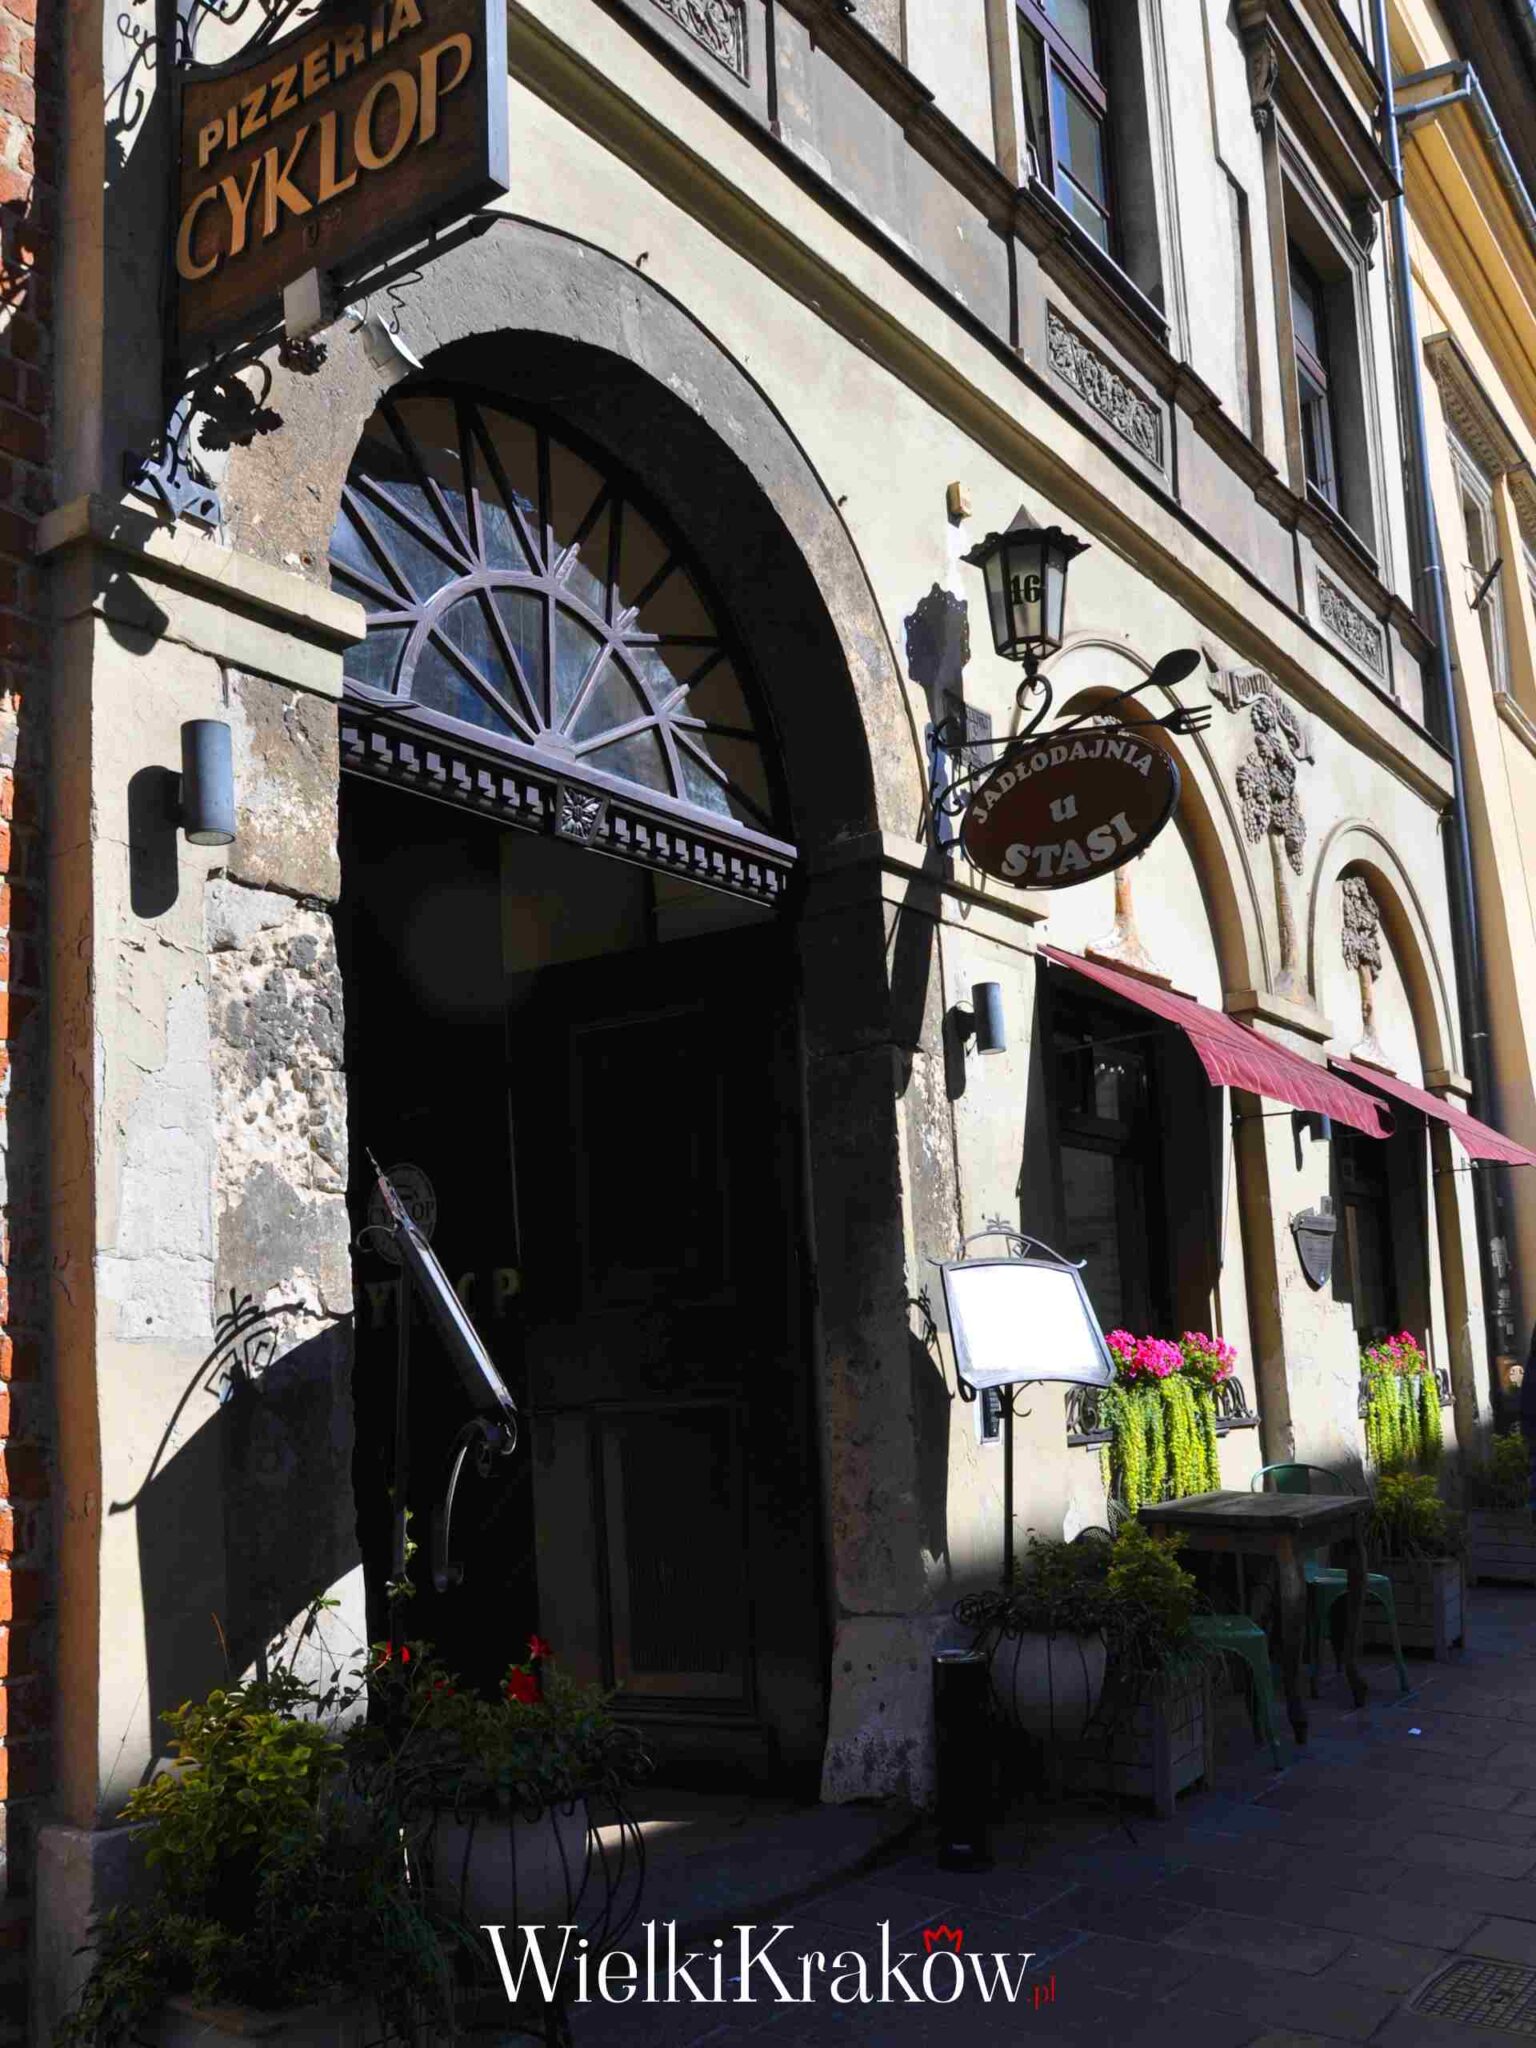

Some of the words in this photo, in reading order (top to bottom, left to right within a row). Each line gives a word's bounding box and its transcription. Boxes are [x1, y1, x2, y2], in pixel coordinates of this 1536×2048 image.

[199, 0, 423, 168] PIZZERIA
[176, 32, 472, 280] CYKLOP
[1010, 574, 1041, 605] 16
[1049, 794, 1078, 822] u
[1001, 811, 1137, 877] STASI
